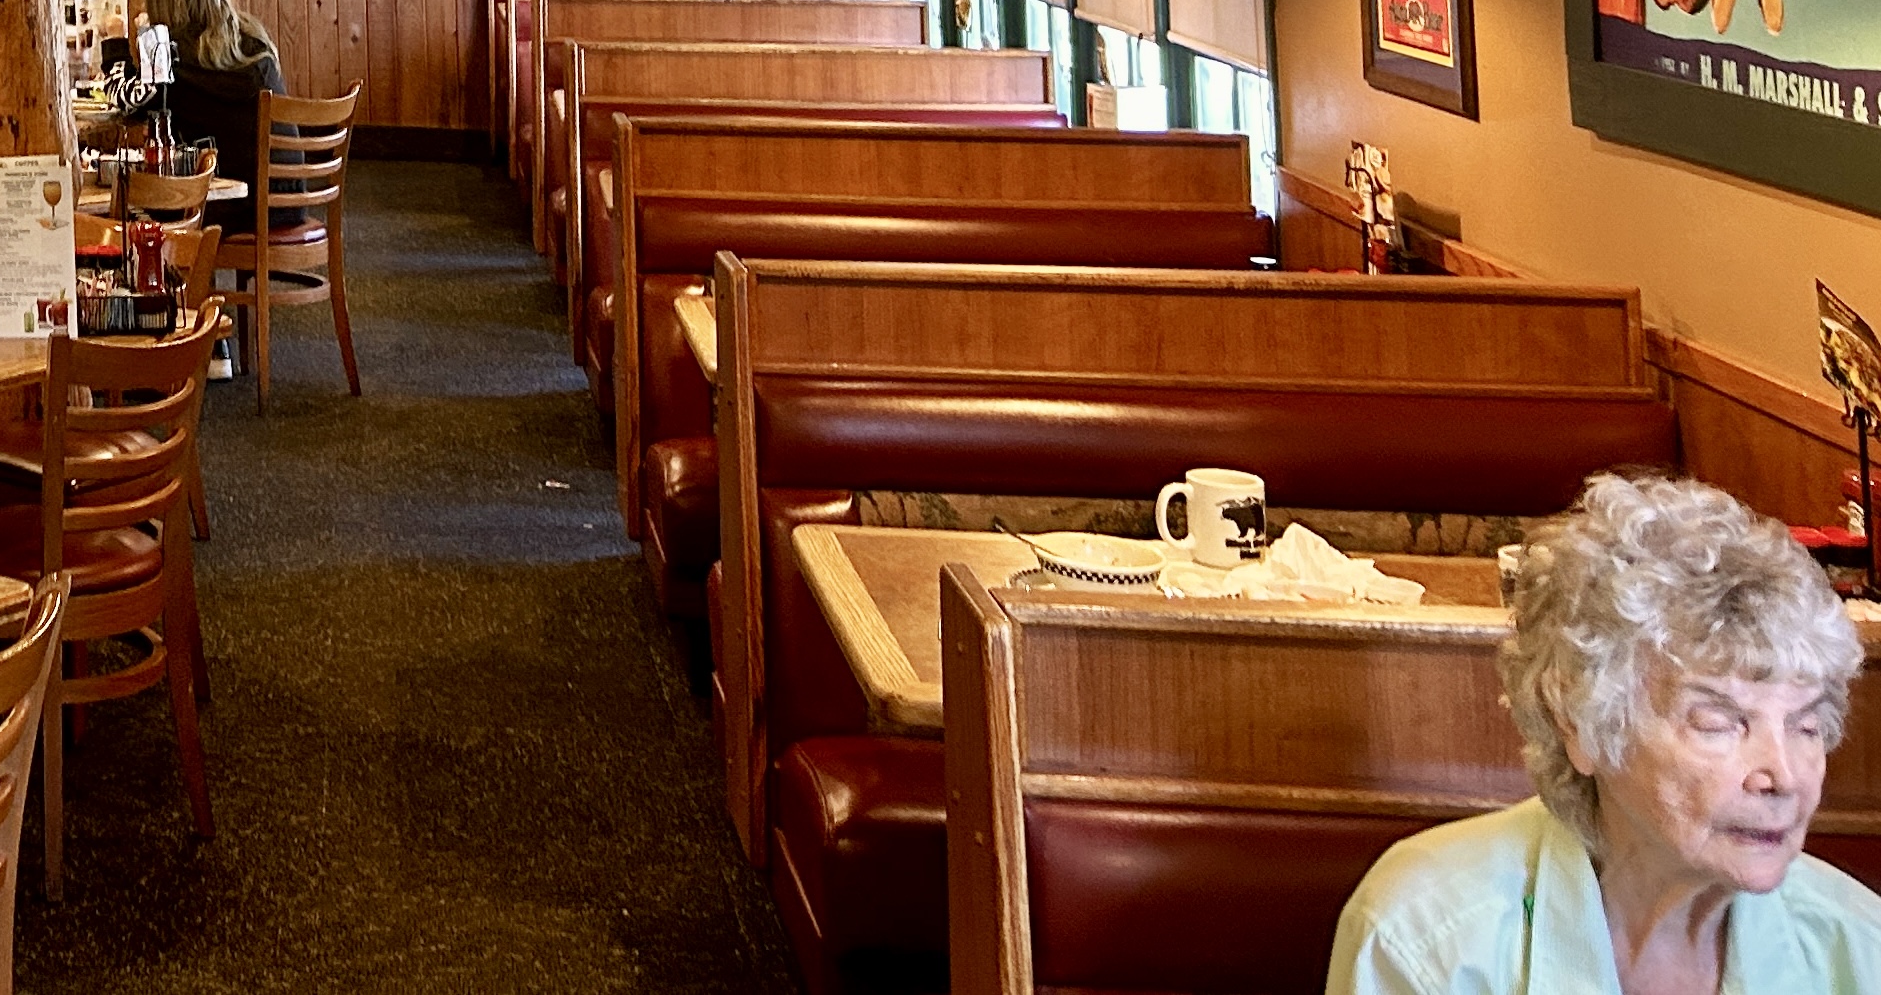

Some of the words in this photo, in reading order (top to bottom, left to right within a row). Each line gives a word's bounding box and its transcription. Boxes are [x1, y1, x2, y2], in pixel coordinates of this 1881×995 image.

[1700, 53, 1718, 91] H.
[1722, 58, 1744, 96] M.
[1749, 63, 1845, 120] MARSHALL
[1853, 85, 1870, 124] &
